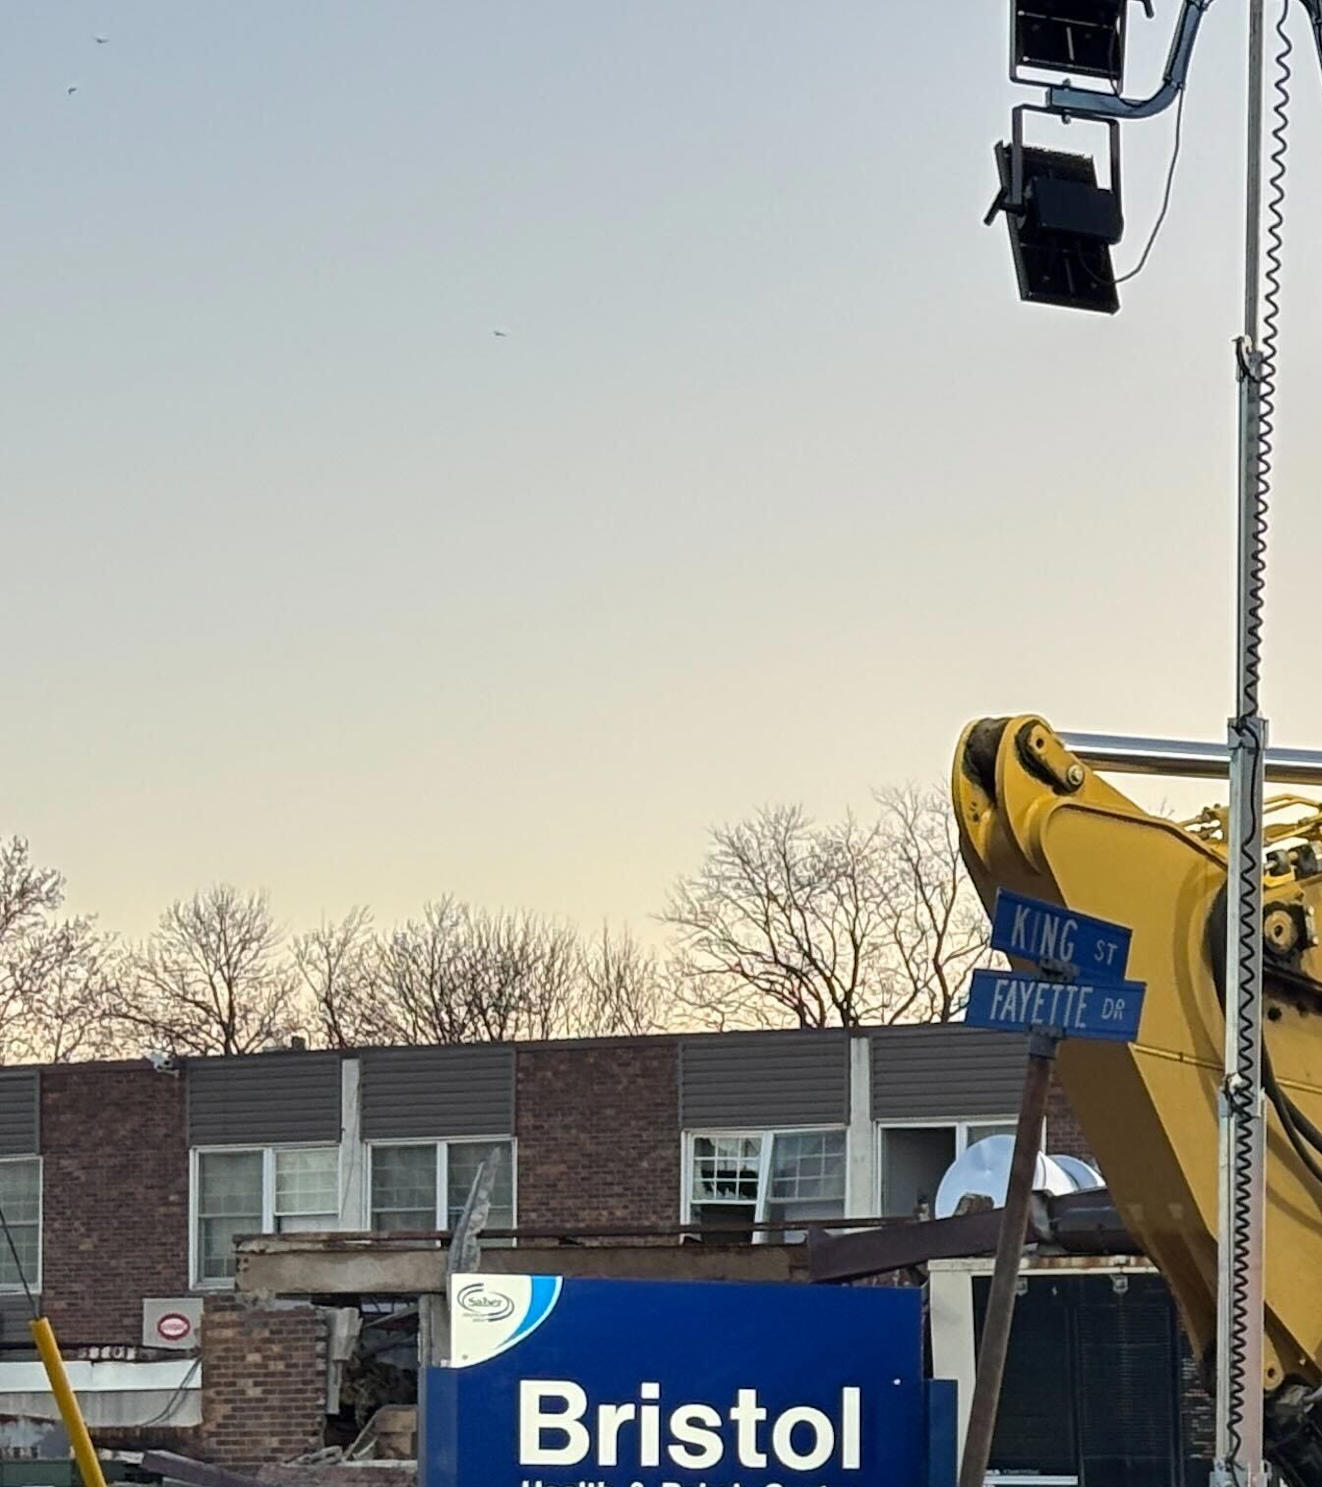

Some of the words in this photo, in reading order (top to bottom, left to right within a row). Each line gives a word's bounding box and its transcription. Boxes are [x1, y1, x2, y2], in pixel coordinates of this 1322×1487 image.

[1011, 904, 1078, 962] KING
[1094, 939, 1118, 965] ST
[990, 979, 1094, 1028] FAYETTE
[1101, 998, 1126, 1020] DR
[519, 1379, 861, 1471] Bristol
